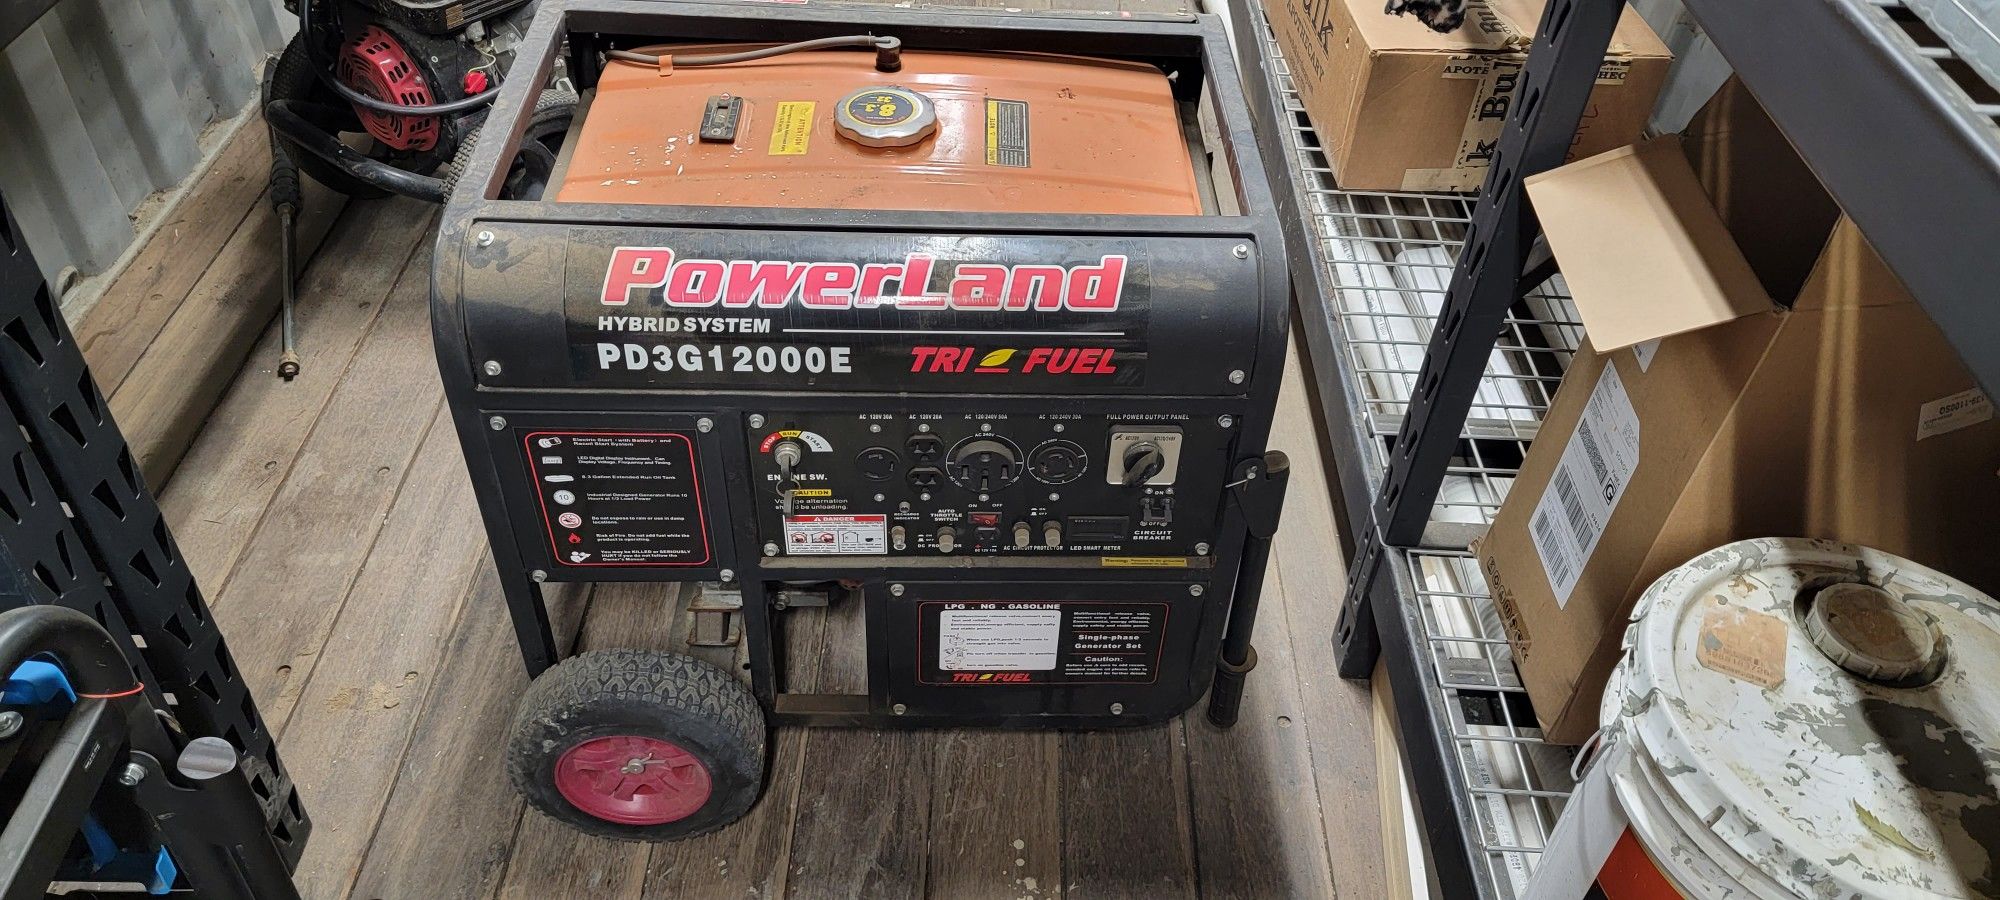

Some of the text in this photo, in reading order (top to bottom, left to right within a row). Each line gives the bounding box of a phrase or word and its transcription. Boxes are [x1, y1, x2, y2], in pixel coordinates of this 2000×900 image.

[600, 246, 1128, 312] PowerLand
[598, 316, 771, 334] HYBRID SYSTEM
[597, 342, 852, 374] PD3G12000E
[910, 346, 1117, 374] TRI FUEL
[806, 436, 822, 450] START
[953, 674, 1031, 682] TRI FUEL
